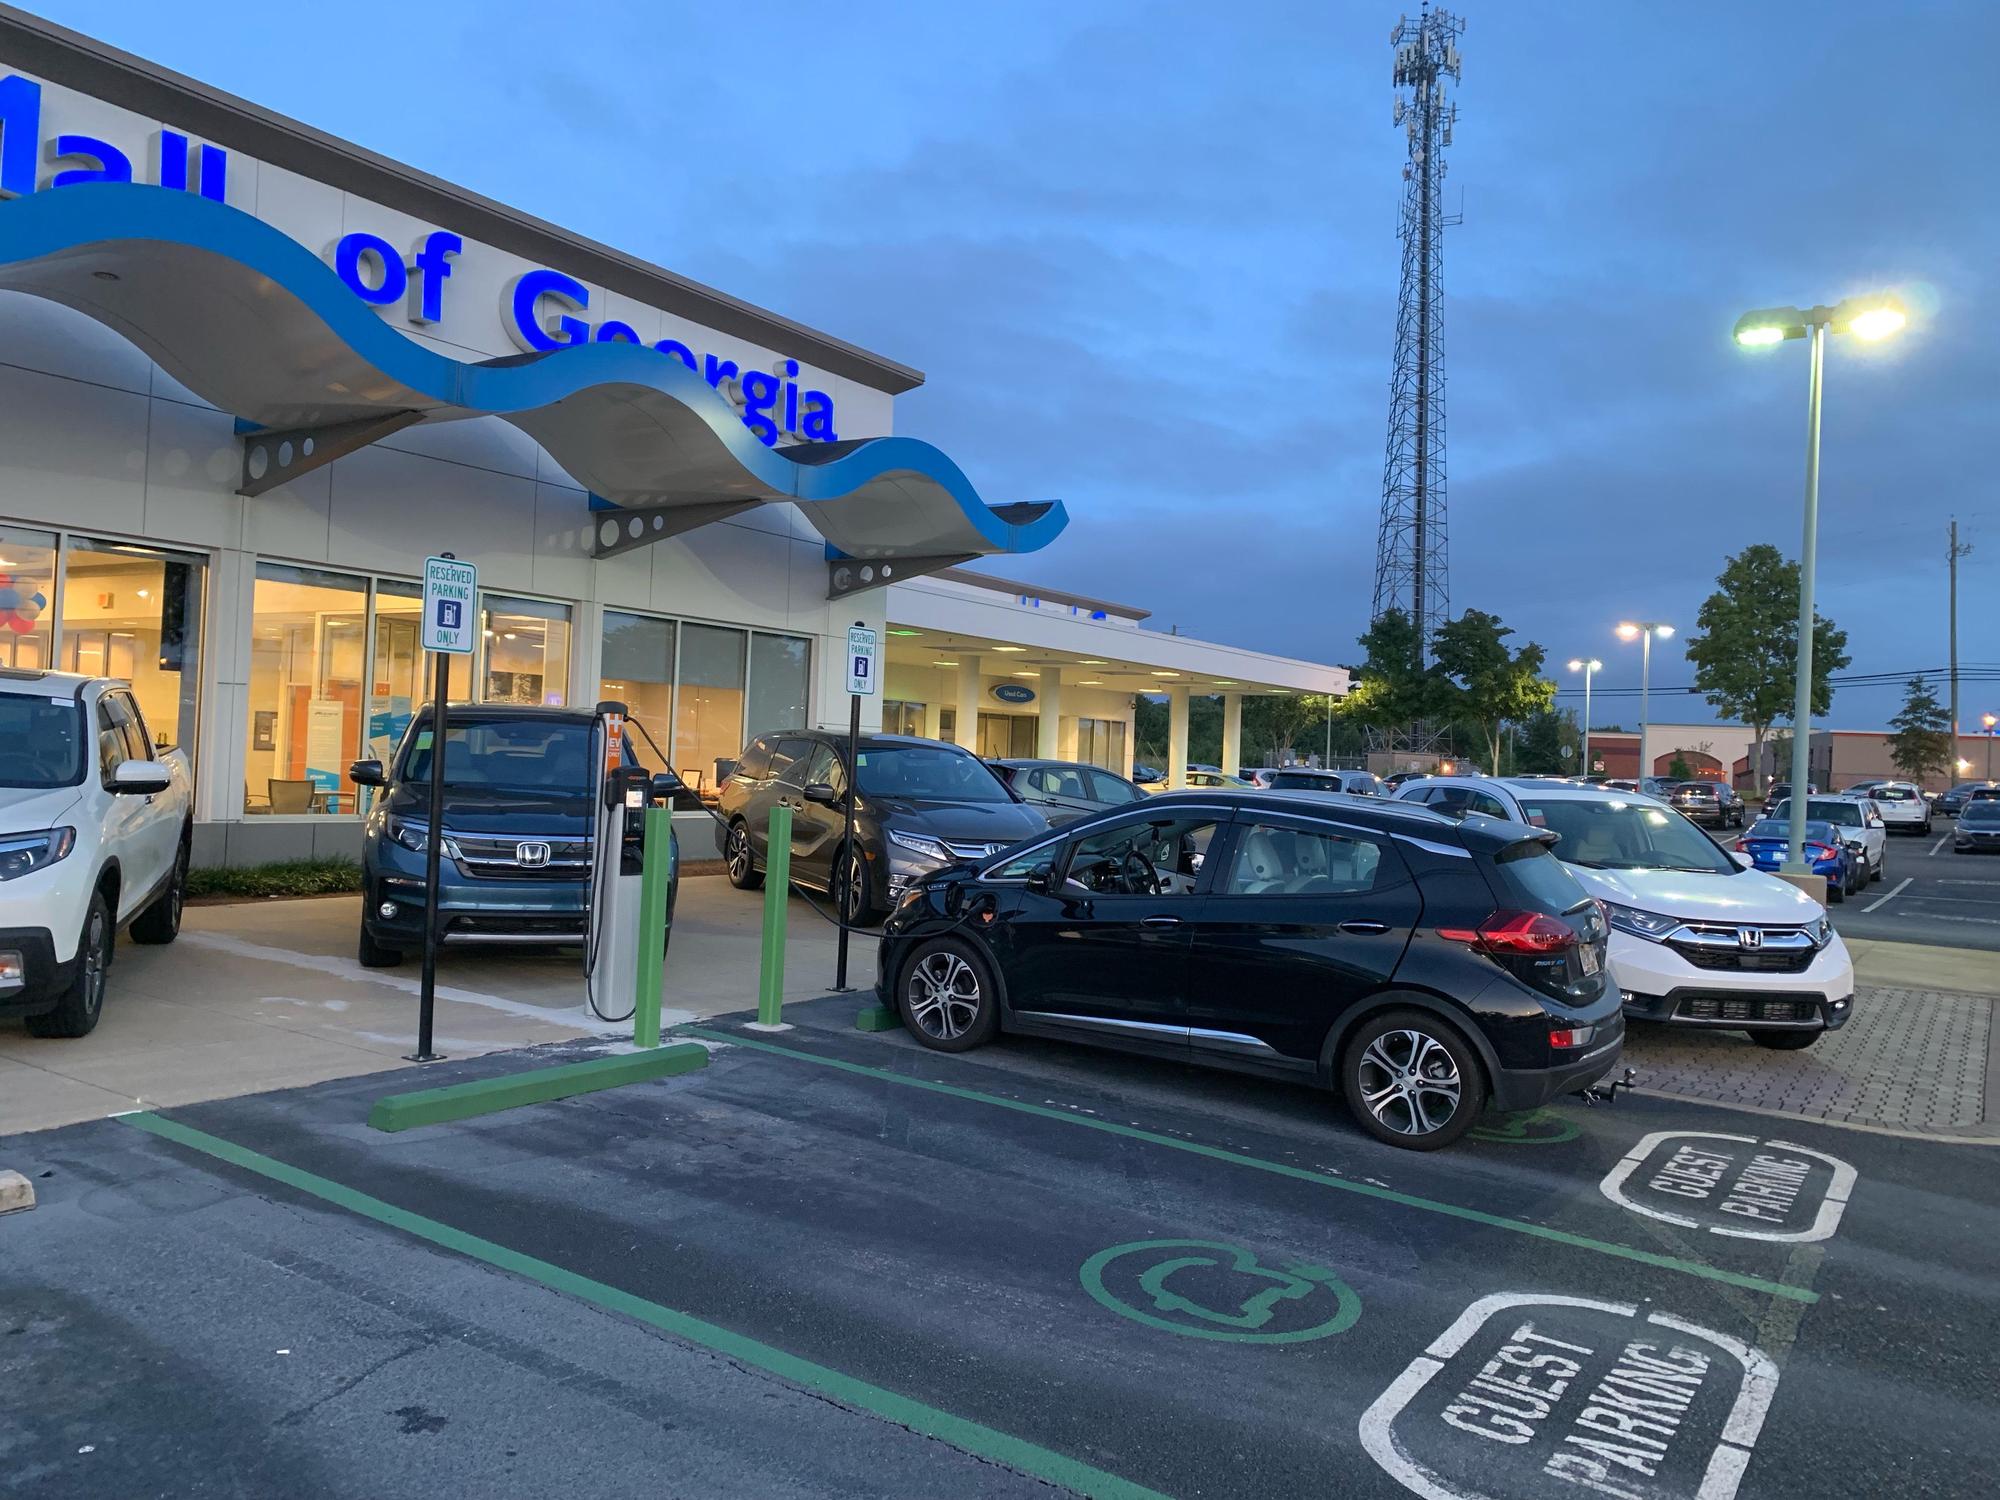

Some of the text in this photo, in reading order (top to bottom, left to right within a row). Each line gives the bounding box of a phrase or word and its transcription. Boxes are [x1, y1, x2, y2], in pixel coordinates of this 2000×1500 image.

[335, 231, 462, 322] of
[430, 566, 472, 584] RESERVED
[431, 583, 469, 600] PARKING
[436, 630, 459, 644] ONLY
[851, 632, 874, 645] RESERVED
[851, 645, 872, 656] PARKING
[854, 679, 867, 689] ONLY
[609, 738, 620, 748] EV
[1649, 1145, 1735, 1198] GUEST
[1719, 1154, 1812, 1223] PARKING
[1440, 1320, 1595, 1444] GUEST
[1543, 1339, 1712, 1500] PARKING
